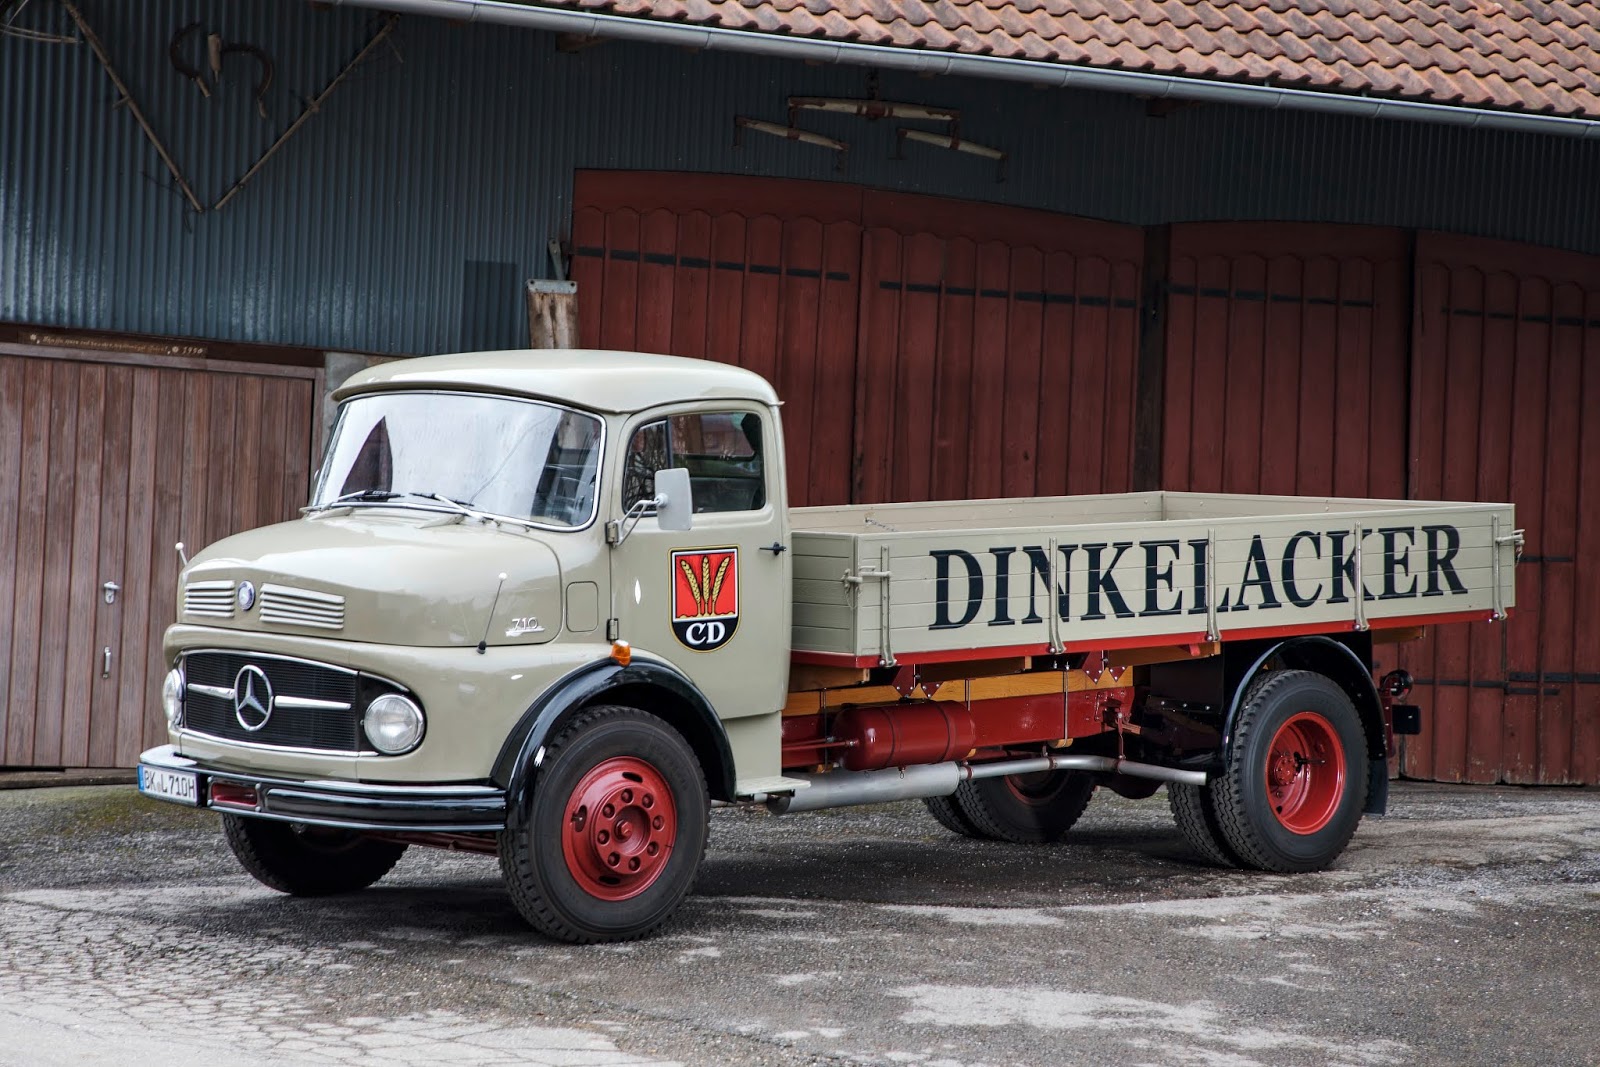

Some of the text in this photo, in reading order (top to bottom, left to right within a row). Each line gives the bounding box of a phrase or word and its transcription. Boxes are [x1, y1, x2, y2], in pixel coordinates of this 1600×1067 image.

[928, 524, 1468, 630] DINKELACKER
[511, 616, 538, 631] 710
[685, 621, 726, 646] CD
